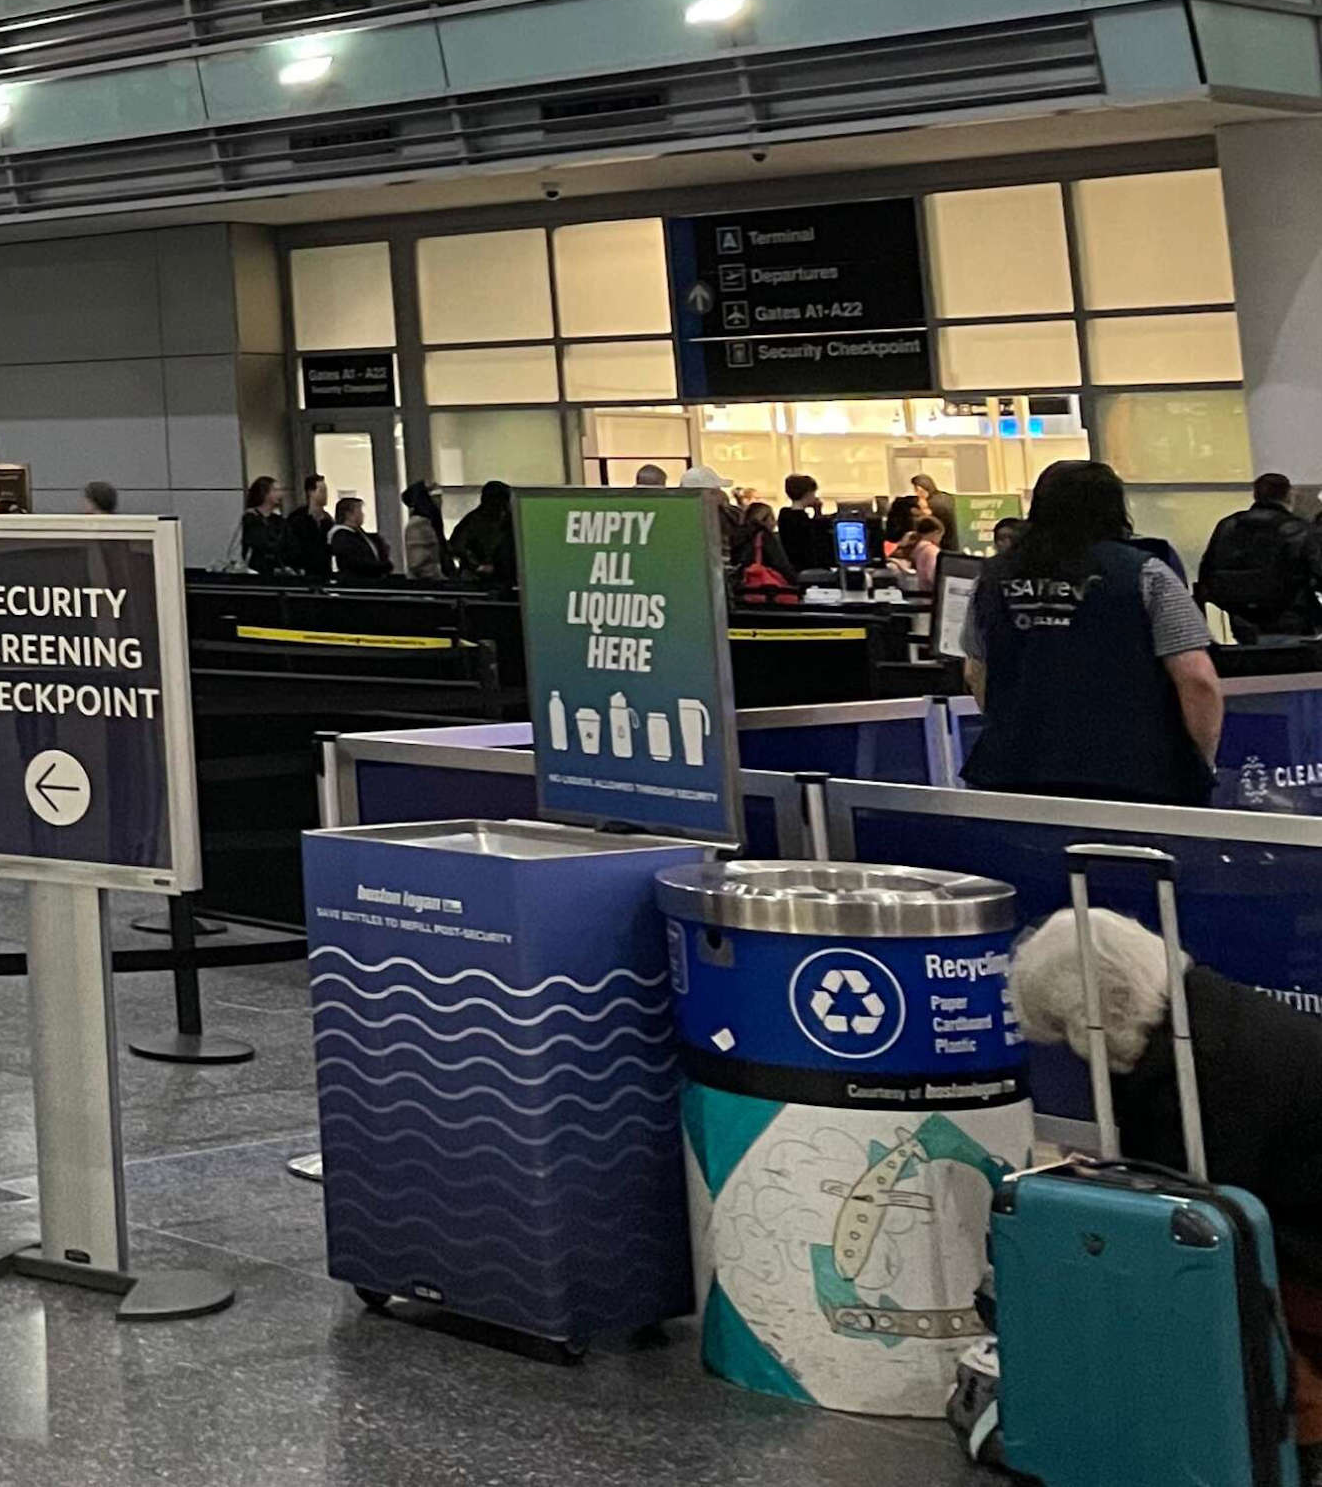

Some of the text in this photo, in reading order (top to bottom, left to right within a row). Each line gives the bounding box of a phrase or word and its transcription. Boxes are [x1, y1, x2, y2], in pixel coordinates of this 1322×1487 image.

[748, 227, 815, 245] Terminal
[751, 266, 839, 286] Departures
[754, 302, 863, 322] Gates A1-A22
[758, 339, 921, 361] Security Checkpoint
[565, 511, 656, 545] EMPTY
[590, 551, 635, 586] ALL
[567, 590, 666, 634] LIQUIDS
[587, 635, 654, 673] HERE
